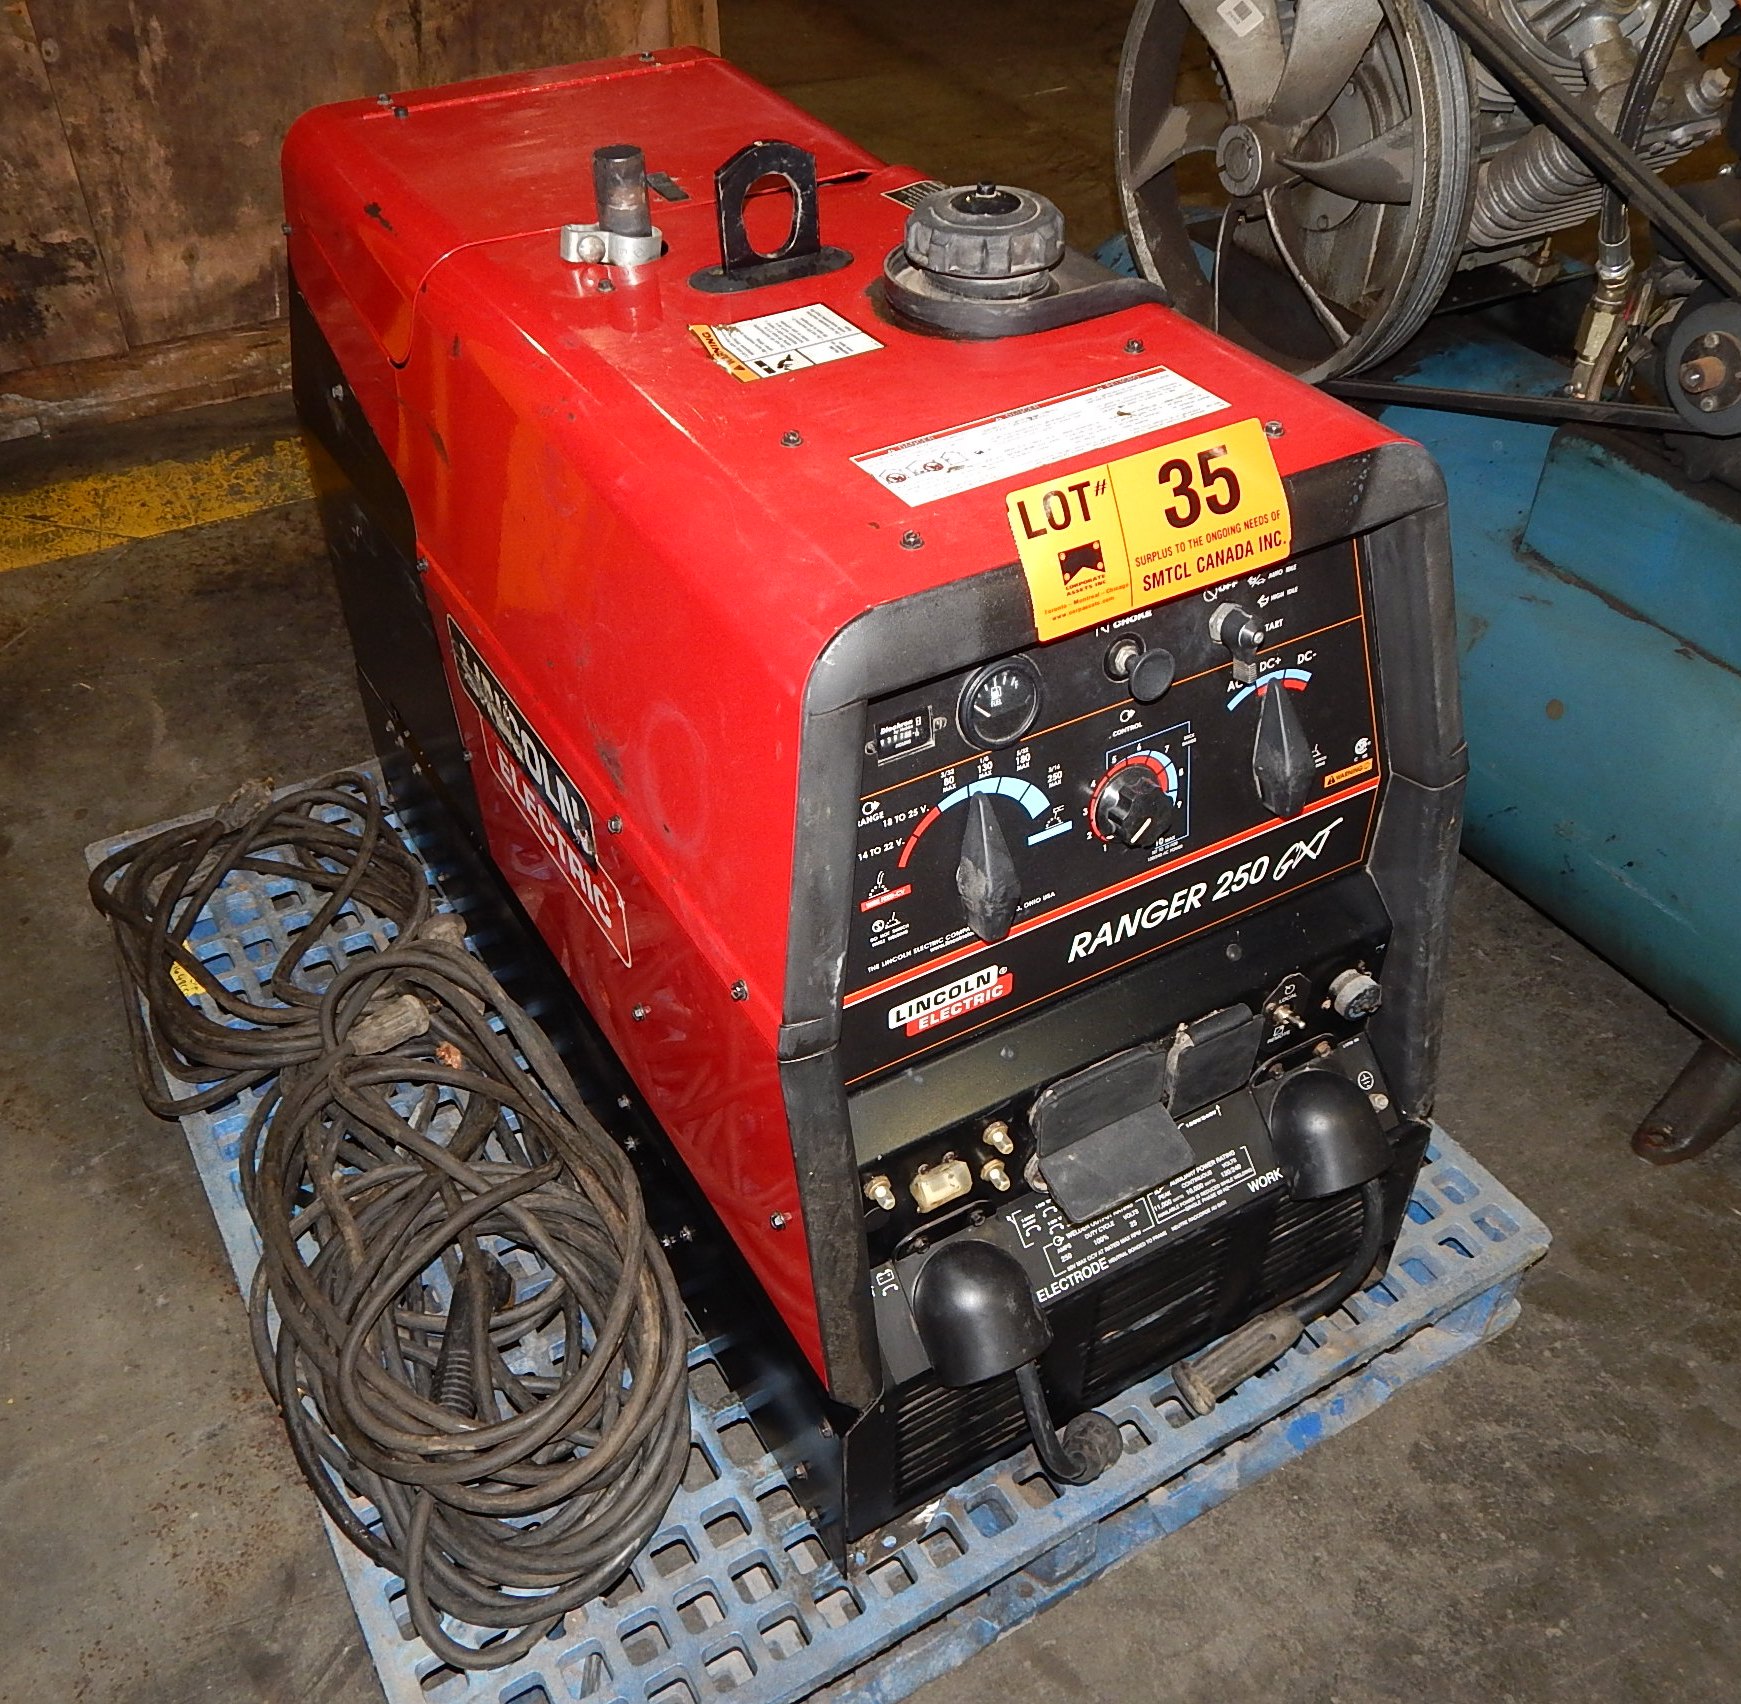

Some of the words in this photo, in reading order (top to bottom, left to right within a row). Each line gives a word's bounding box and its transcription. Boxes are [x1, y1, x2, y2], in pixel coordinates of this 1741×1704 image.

[1158, 444, 1241, 529] 35
[1135, 546, 1173, 568] SURPLUS
[1176, 541, 1186, 553] TO
[1187, 535, 1204, 550] THE
[1206, 523, 1242, 544] ONGOING
[1243, 514, 1269, 533] NEEDS
[1271, 510, 1281, 522] OF
[1142, 564, 1192, 592] SMTCL
[1197, 540, 1254, 573] CANADA
[1258, 530, 1287, 552] INC.
[1065, 574, 1105, 591] CORPORATE
[1066, 585, 1093, 597] ASSETS
[1095, 580, 1106, 588] INC
[1073, 592, 1100, 605] Montreal
[1106, 582, 1130, 595] Chicago
[1264, 618, 1284, 633] TART
[1259, 656, 1282, 673] DC+
[1297, 650, 1318, 665] DC-
[1112, 721, 1143, 738] CONTROL
[1164, 744, 1171, 754] 7
[976, 761, 993, 773] 130
[1111, 755, 1118, 764] 5
[1335, 765, 1363, 780] WARNING
[942, 783, 957, 793] MAX
[1090, 779, 1097, 788] 4
[882, 818, 893, 828] 18
[894, 813, 907, 824] TO
[907, 809, 919, 819] 25
[1082, 807, 1089, 817] 3
[496, 741, 613, 929] ELECTRIC
[1086, 831, 1093, 841] 2
[858, 851, 869, 862] 14
[869, 846, 882, 857] TO
[883, 841, 895, 852] 22
[1102, 843, 1108, 853] 1
[1068, 881, 1208, 964] RANGER
[1211, 855, 1270, 903] 250
[1272, 817, 1344, 882] GXT
[867, 964, 880, 974] THE
[881, 950, 912, 967] LINCOLN
[913, 936, 944, 954] ELECTRIC
[945, 926, 971, 941] COMPA
[895, 971, 991, 1023] LINCOLN
[917, 985, 1004, 1031] ELECTRIC
[1195, 1159, 1217, 1173] POWER
[1216, 1150, 1236, 1164] RATING
[1247, 1167, 1284, 1193] WORK
[1084, 1229, 1098, 1239] DUTY
[1098, 1220, 1116, 1233] CYCLE
[1035, 1256, 1110, 1303] ELECTRODE
